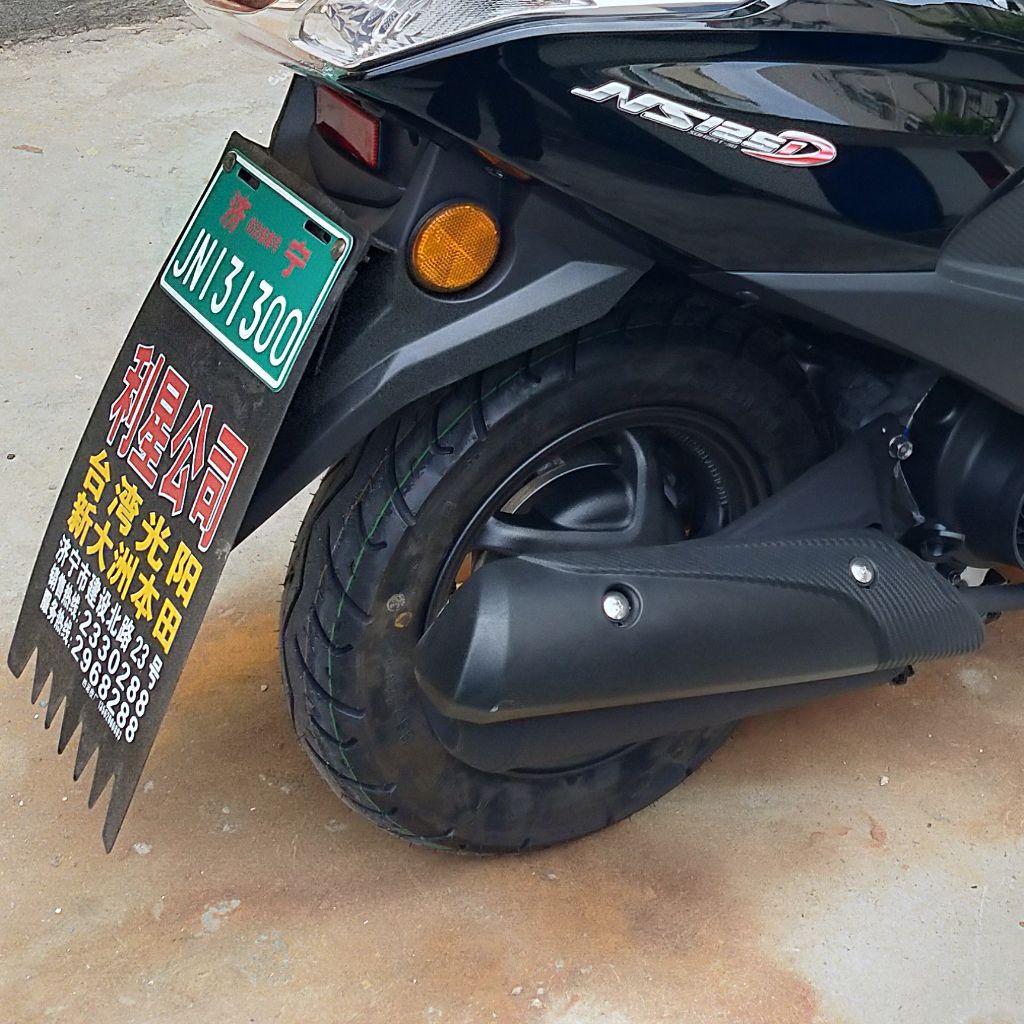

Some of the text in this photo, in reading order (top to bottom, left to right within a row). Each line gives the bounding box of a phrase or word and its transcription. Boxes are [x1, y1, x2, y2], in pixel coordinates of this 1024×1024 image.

[172, 228, 303, 367] JN131300
[219, 189, 252, 233] 济
[281, 239, 312, 277] 宁
[106, 344, 249, 552] 利星公司
[66, 491, 182, 655] 新大洲本田
[82, 449, 202, 608] 台湾光阳
